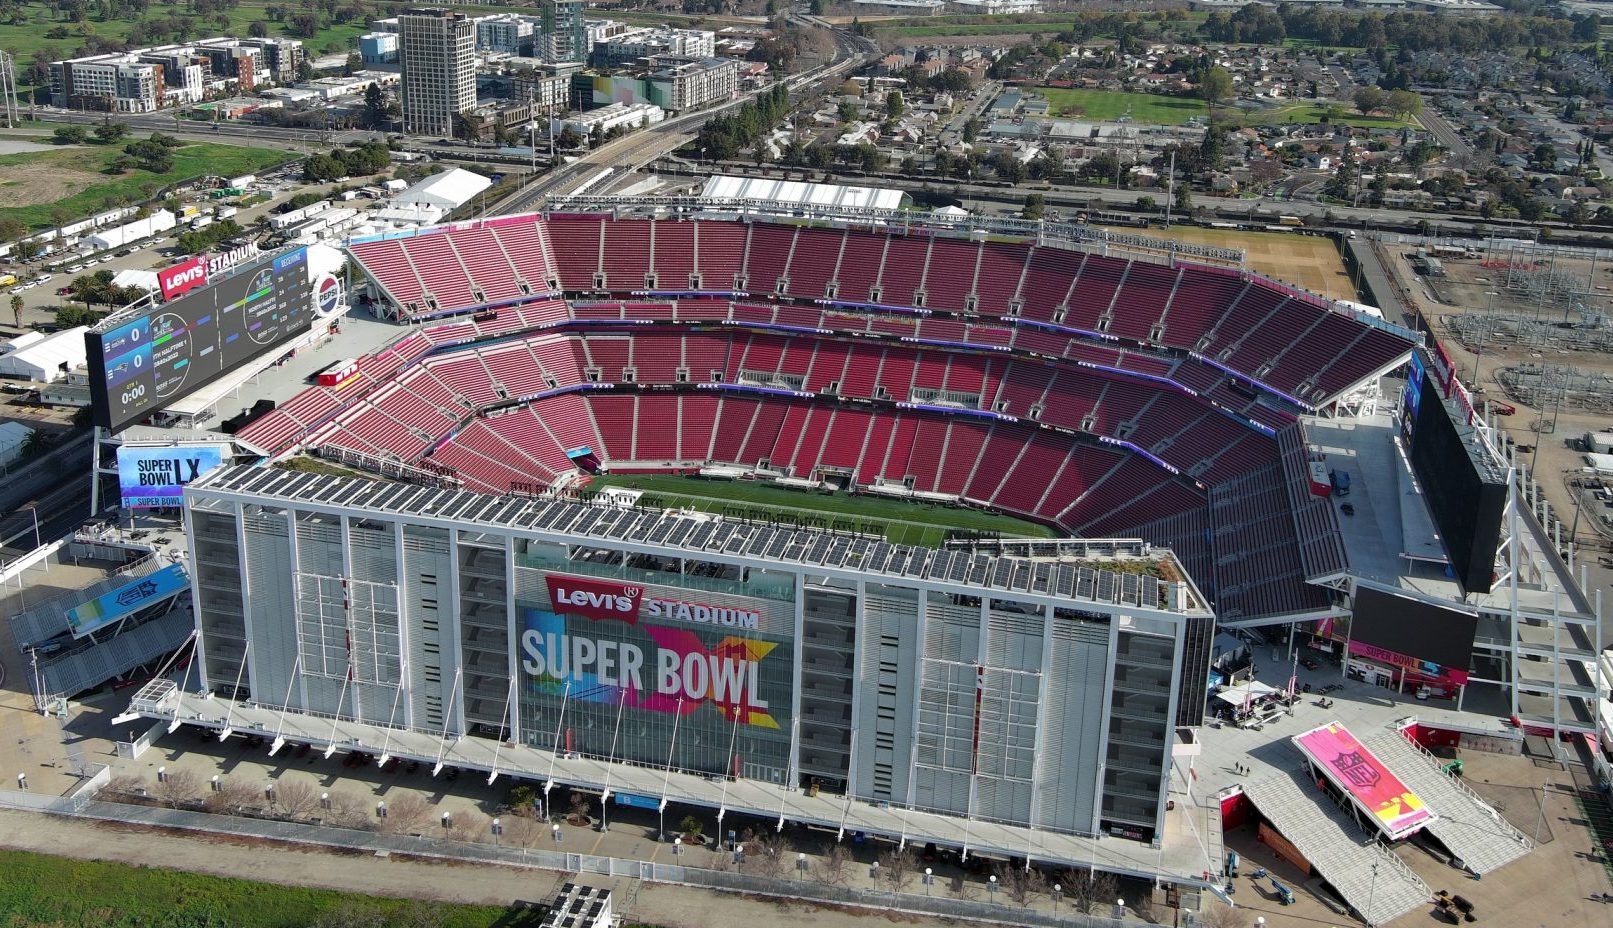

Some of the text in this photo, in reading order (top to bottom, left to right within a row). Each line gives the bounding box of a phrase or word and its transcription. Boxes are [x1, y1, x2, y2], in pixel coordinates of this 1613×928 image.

[210, 241, 258, 272] STADIUM
[319, 290, 338, 302] PEPSI
[131, 328, 139, 341] 0
[134, 354, 142, 368] 0
[122, 384, 145, 404] 0:00
[137, 459, 172, 472] SUPER
[174, 459, 200, 485] LX
[139, 472, 174, 486] BOWL
[137, 497, 181, 506] SUPER BOWL
[648, 600, 759, 629] STADIUM
[1365, 646, 1416, 668] SUPER BOWL
[521, 629, 769, 709] SUPER BOWL
